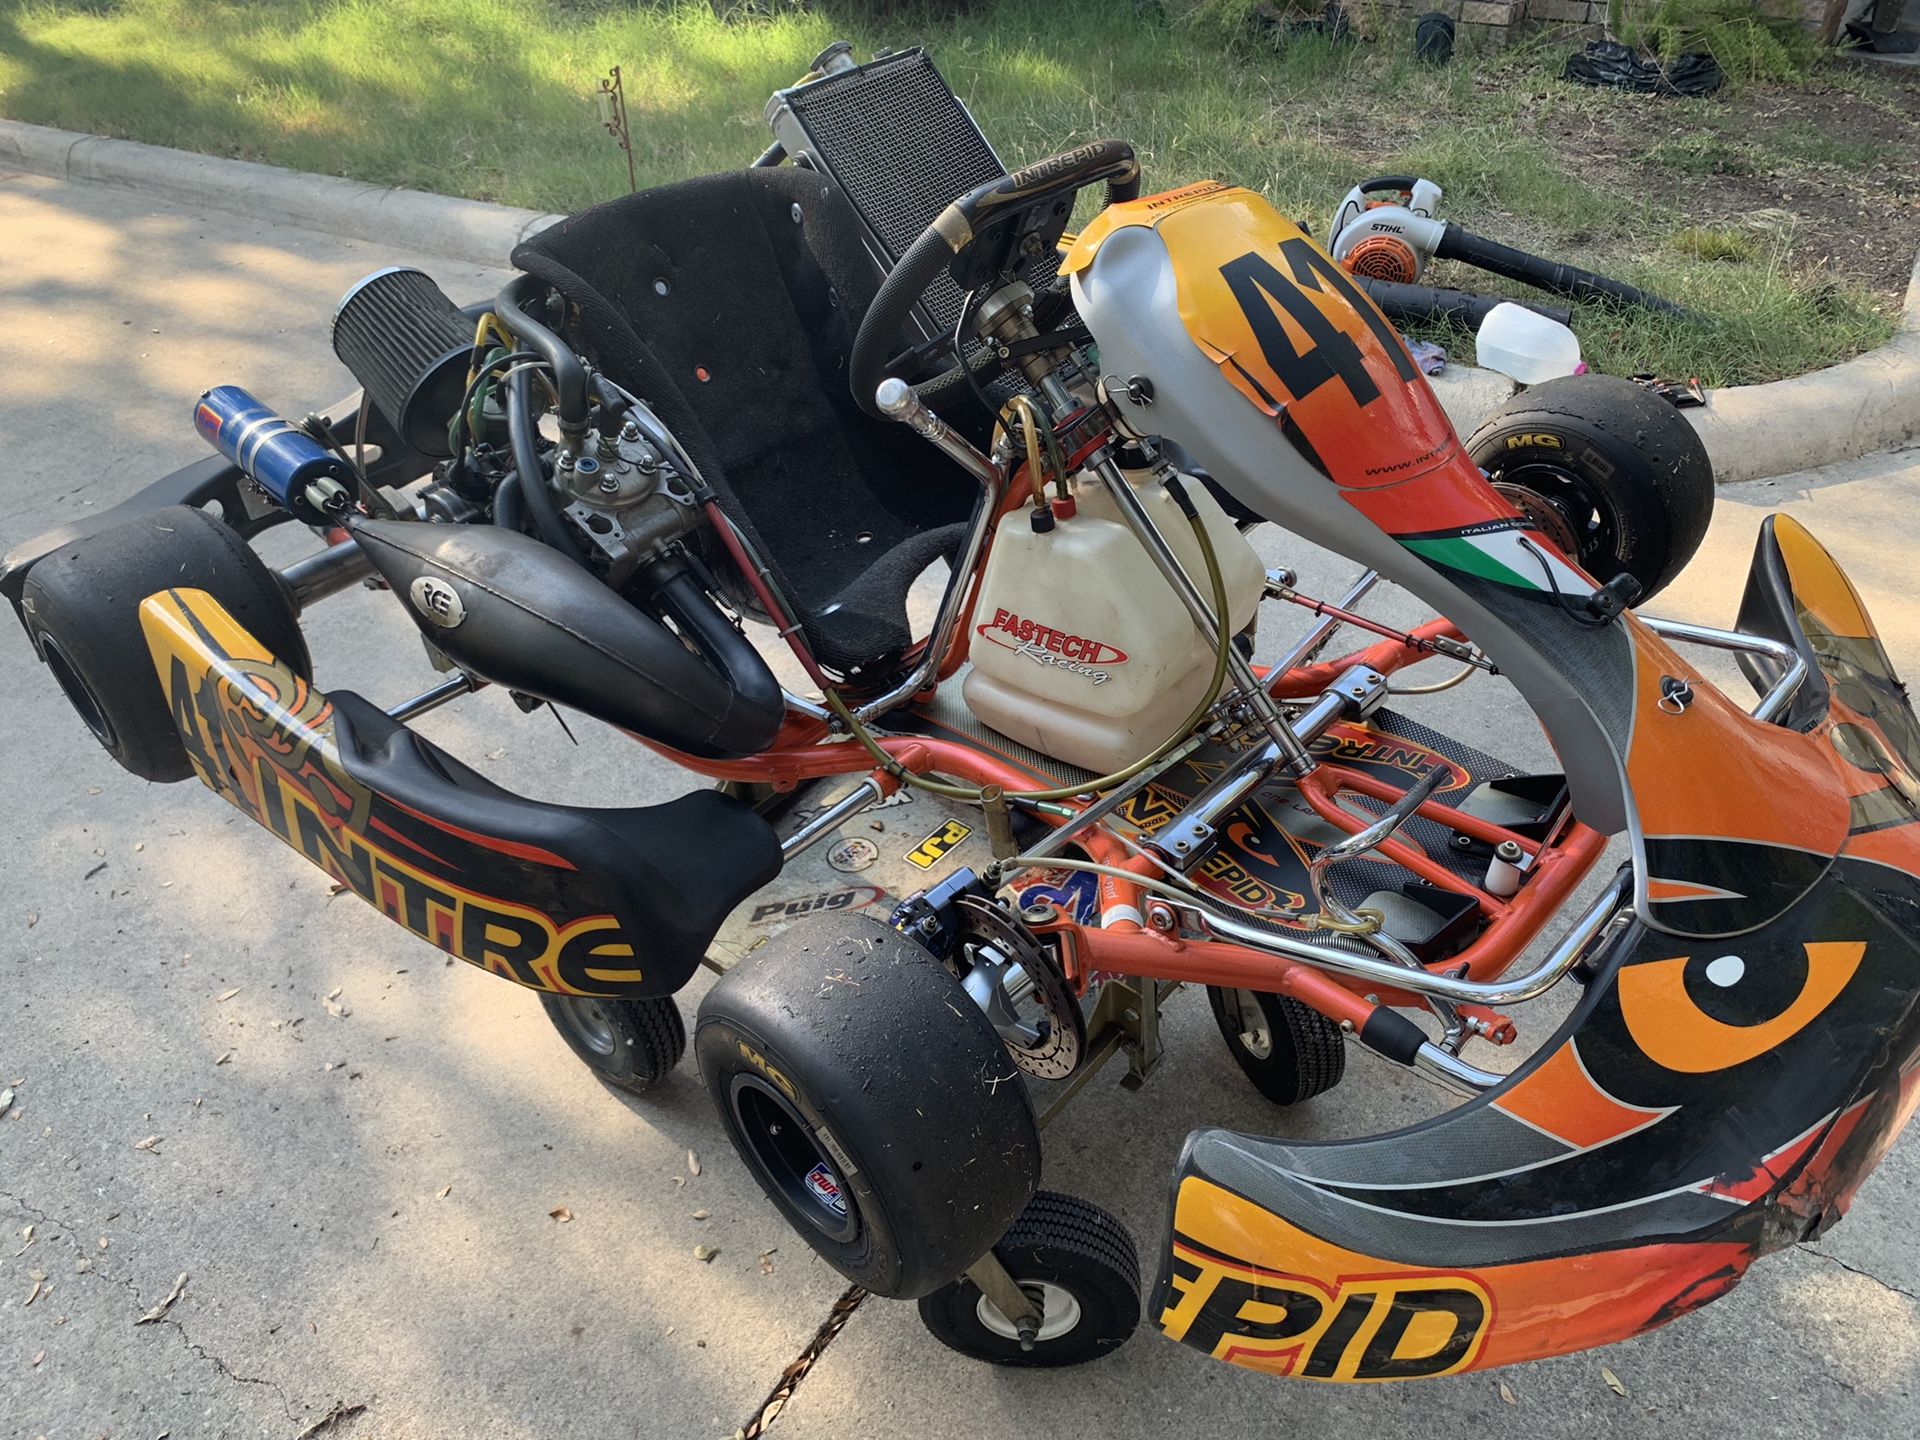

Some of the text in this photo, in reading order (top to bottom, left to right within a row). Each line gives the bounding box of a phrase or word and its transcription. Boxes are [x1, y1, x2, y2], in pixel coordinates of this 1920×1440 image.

[1011, 143, 1106, 188] INTREPID
[1146, 185, 1220, 210] INTREPID
[1371, 223, 1403, 234] STIHL
[1219, 237, 1418, 408] 41
[1507, 433, 1561, 449] MG
[1461, 522, 1510, 535] ITALIAN
[992, 608, 1103, 664] FASTECH
[1012, 640, 1112, 685] Racing
[907, 821, 970, 868] PJ1
[751, 891, 856, 922] Puig
[738, 1043, 796, 1099] MG
